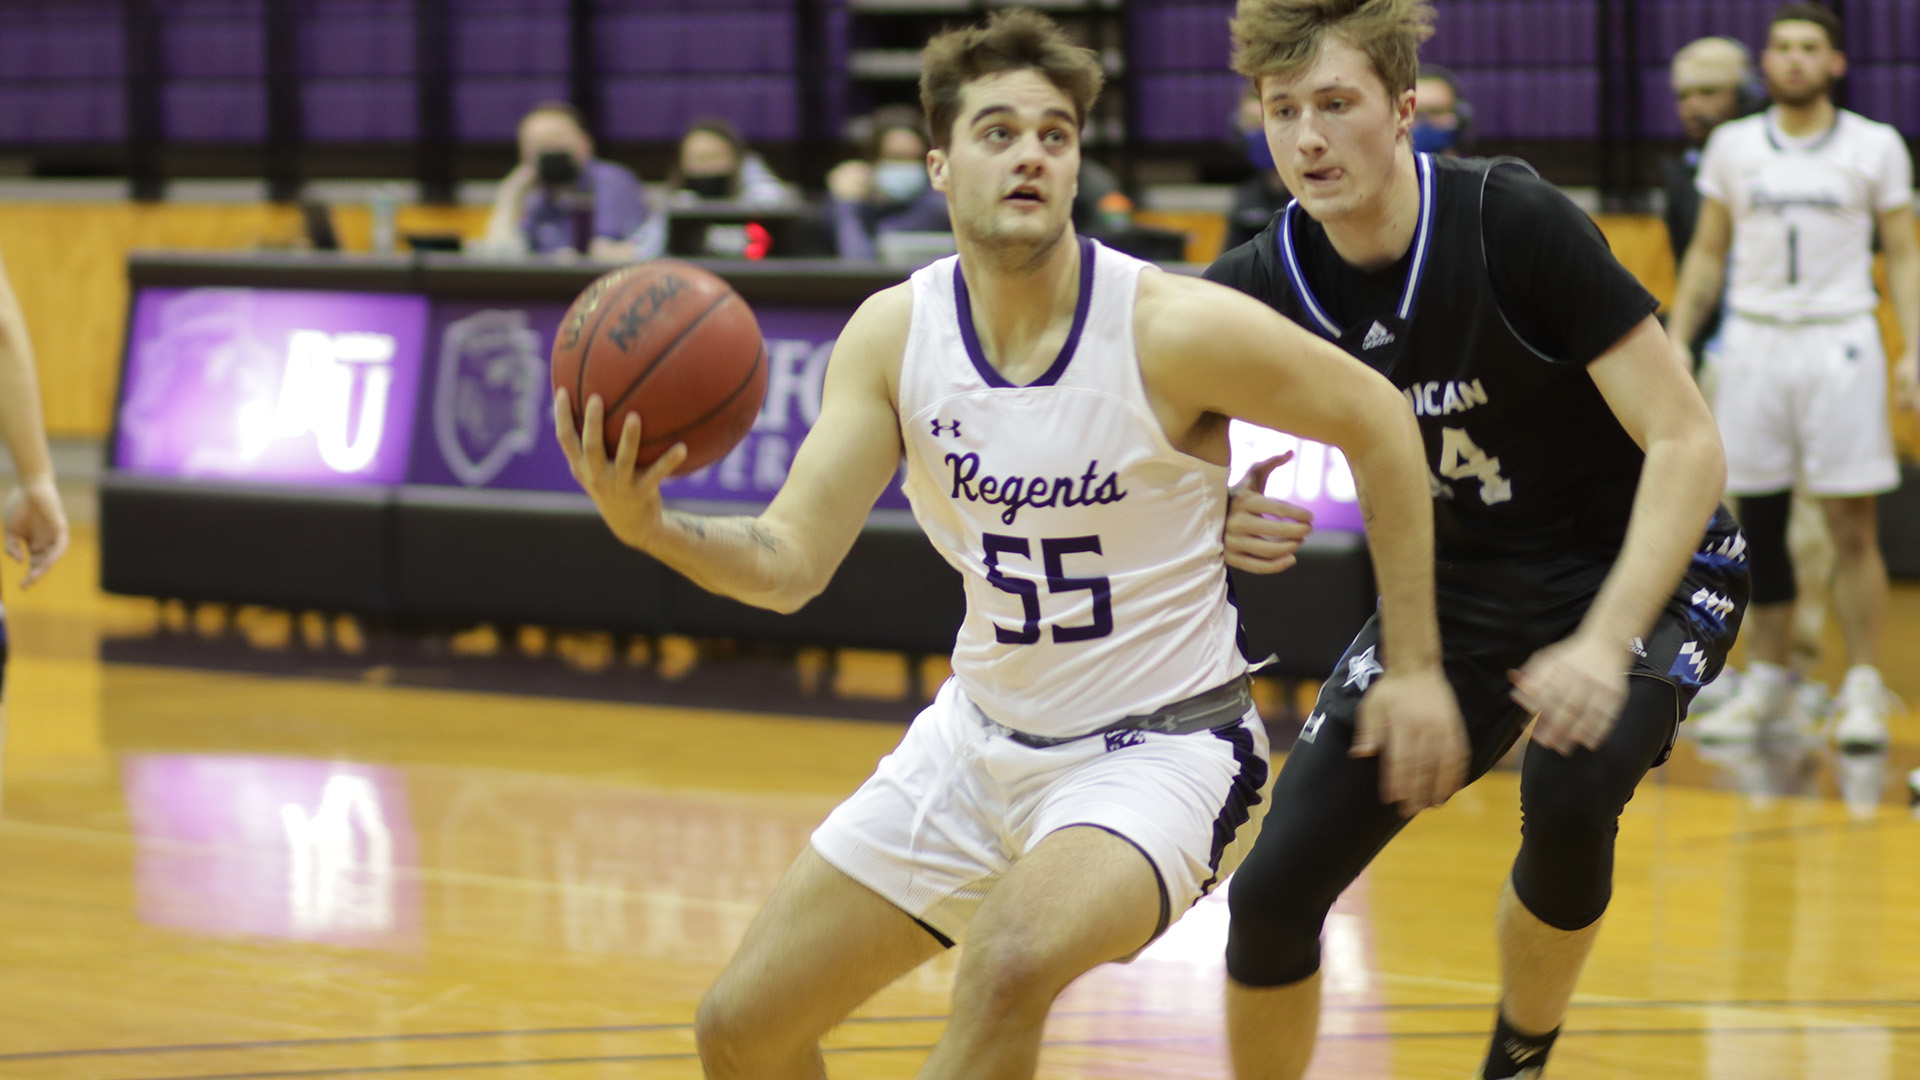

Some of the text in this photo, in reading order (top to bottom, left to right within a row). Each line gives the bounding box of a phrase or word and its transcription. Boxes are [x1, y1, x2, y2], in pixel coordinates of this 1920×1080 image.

[945, 452, 1128, 525] Regents
[1429, 426, 1513, 506] 4
[982, 532, 1113, 645] 55
